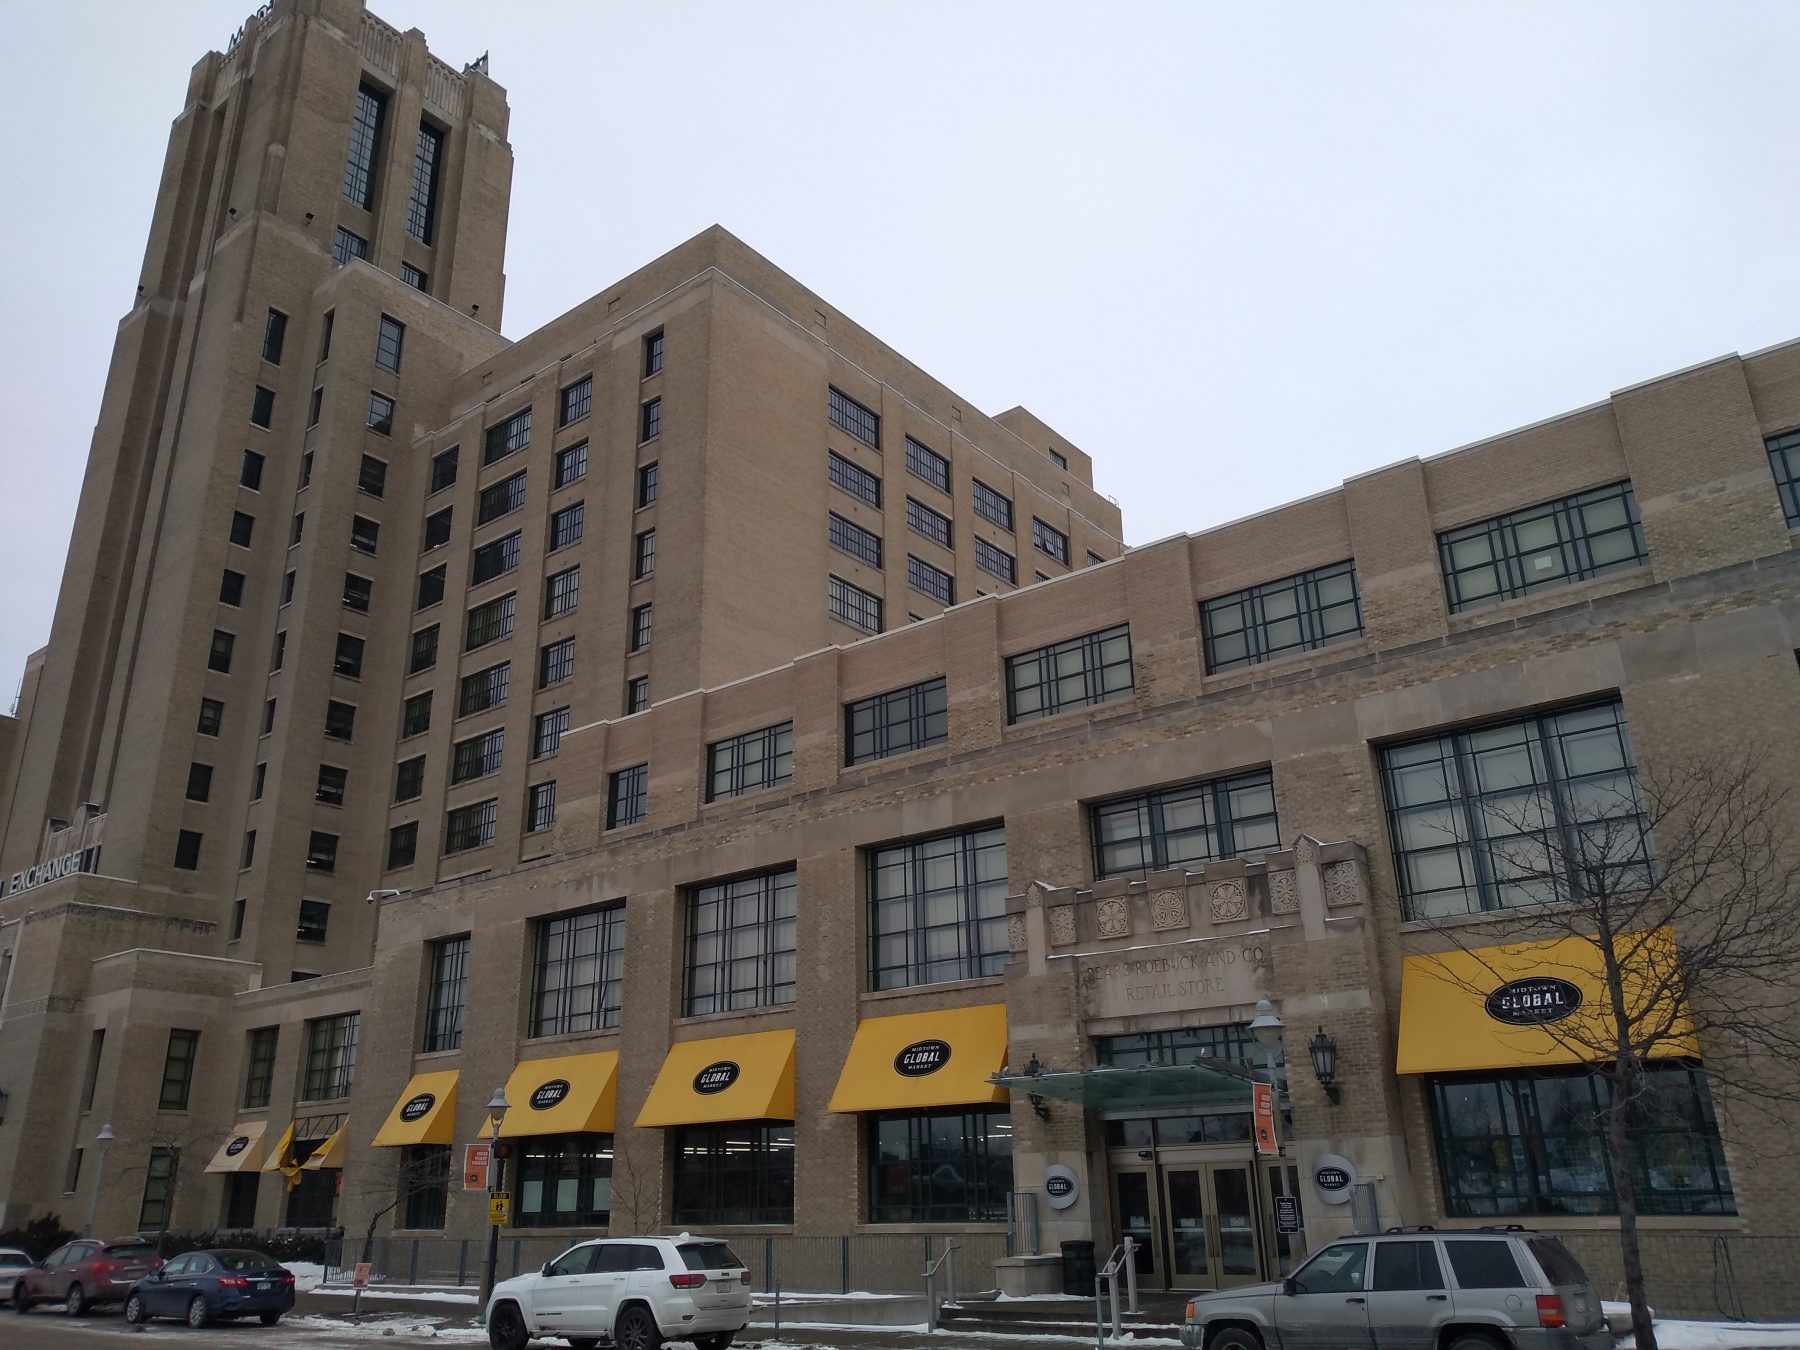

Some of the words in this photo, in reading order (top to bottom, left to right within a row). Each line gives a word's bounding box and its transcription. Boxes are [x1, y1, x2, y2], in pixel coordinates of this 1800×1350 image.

[9, 849, 81, 894] EXCHANGE
[1205, 950, 1235, 967] AND
[1127, 983, 1175, 1001] RETAIL
[1179, 978, 1225, 996] STORE
[1502, 992, 1564, 1009] GLOBAL
[903, 1051, 940, 1064] GLOBAL
[700, 1072, 731, 1083] GLOBAL
[536, 1089, 562, 1100] GLOBAL
[1319, 1175, 1344, 1183] GLOBAL
